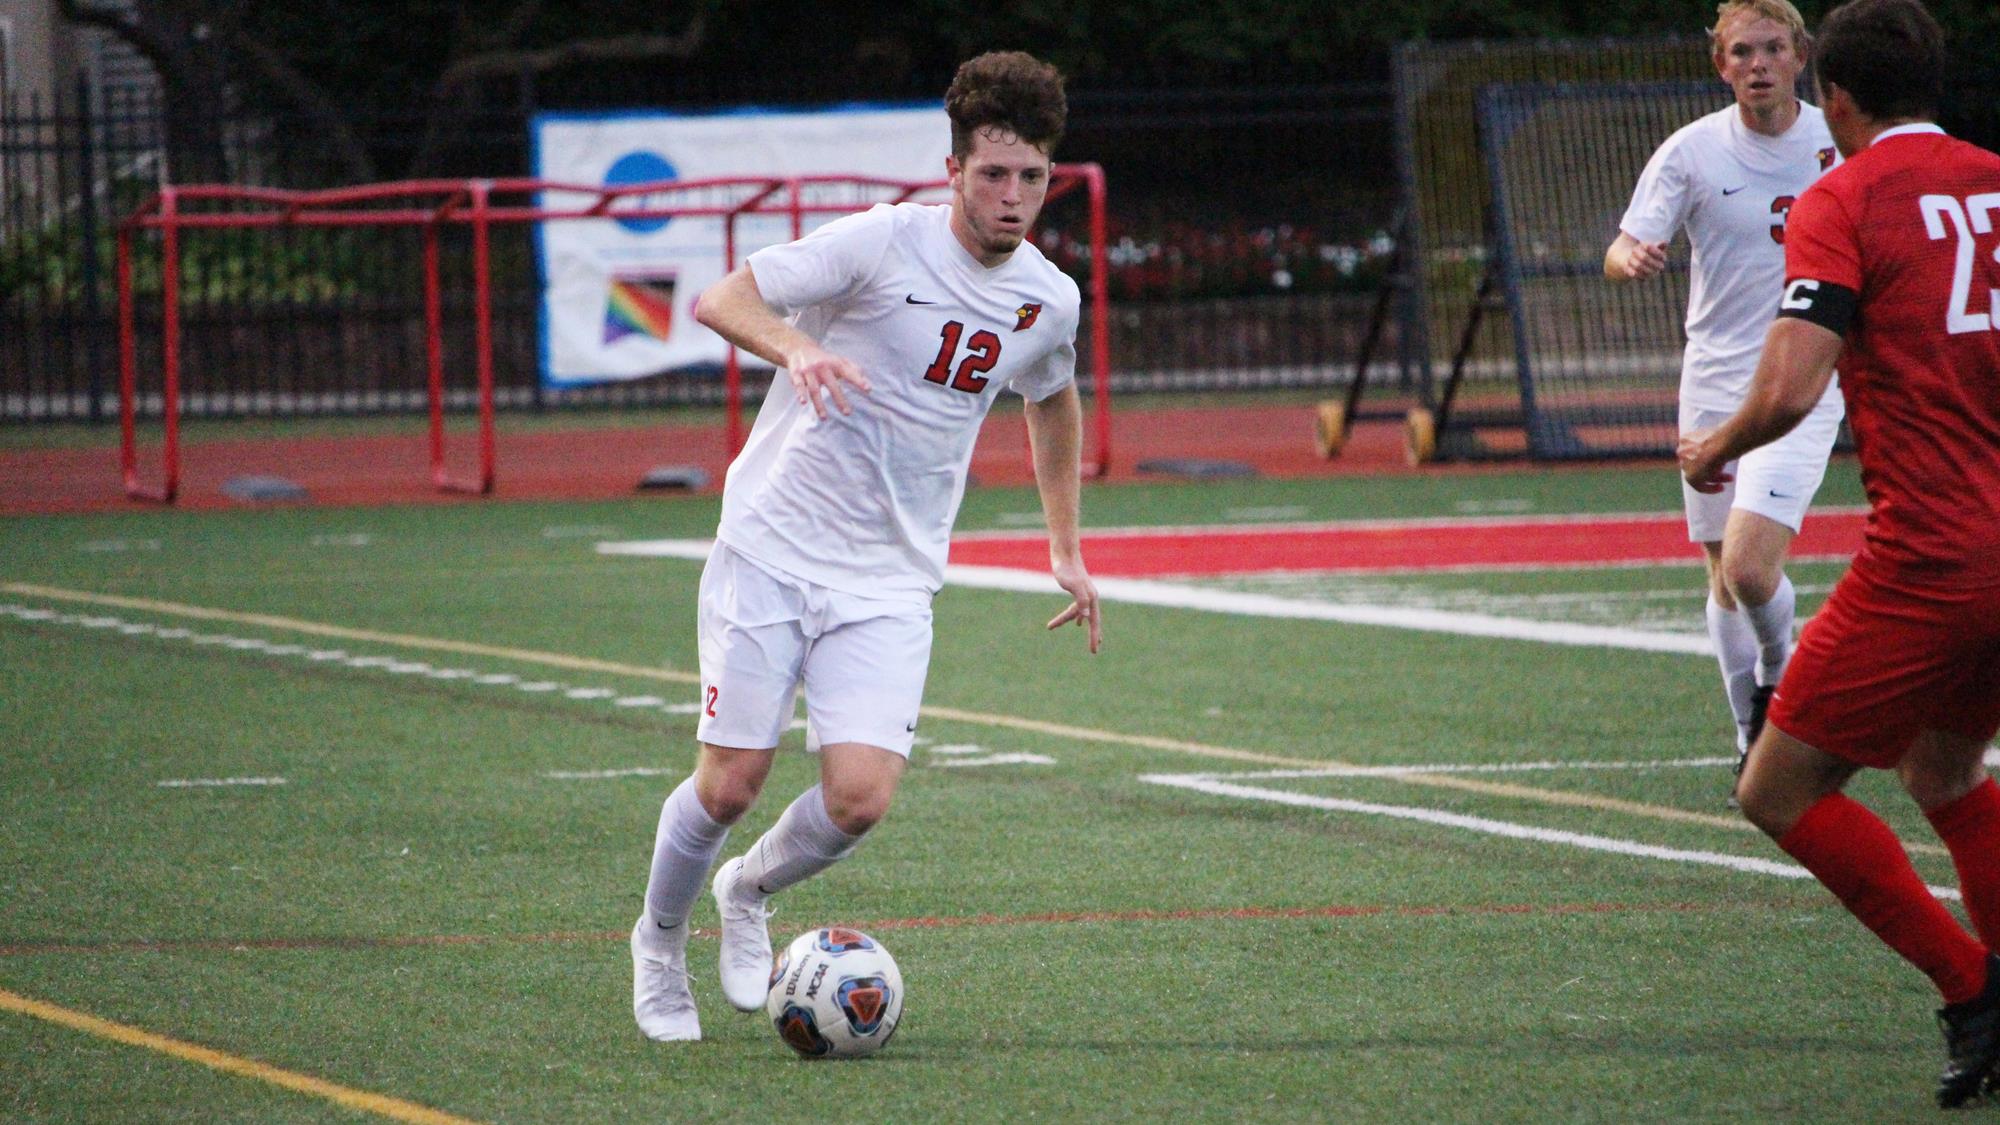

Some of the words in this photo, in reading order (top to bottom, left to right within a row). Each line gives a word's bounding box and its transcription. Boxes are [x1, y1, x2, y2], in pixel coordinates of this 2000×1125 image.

[1781, 279, 1820, 310] C
[923, 320, 1002, 394] 12
[786, 953, 811, 996] Wilson
[805, 962, 829, 1001] NCAA
